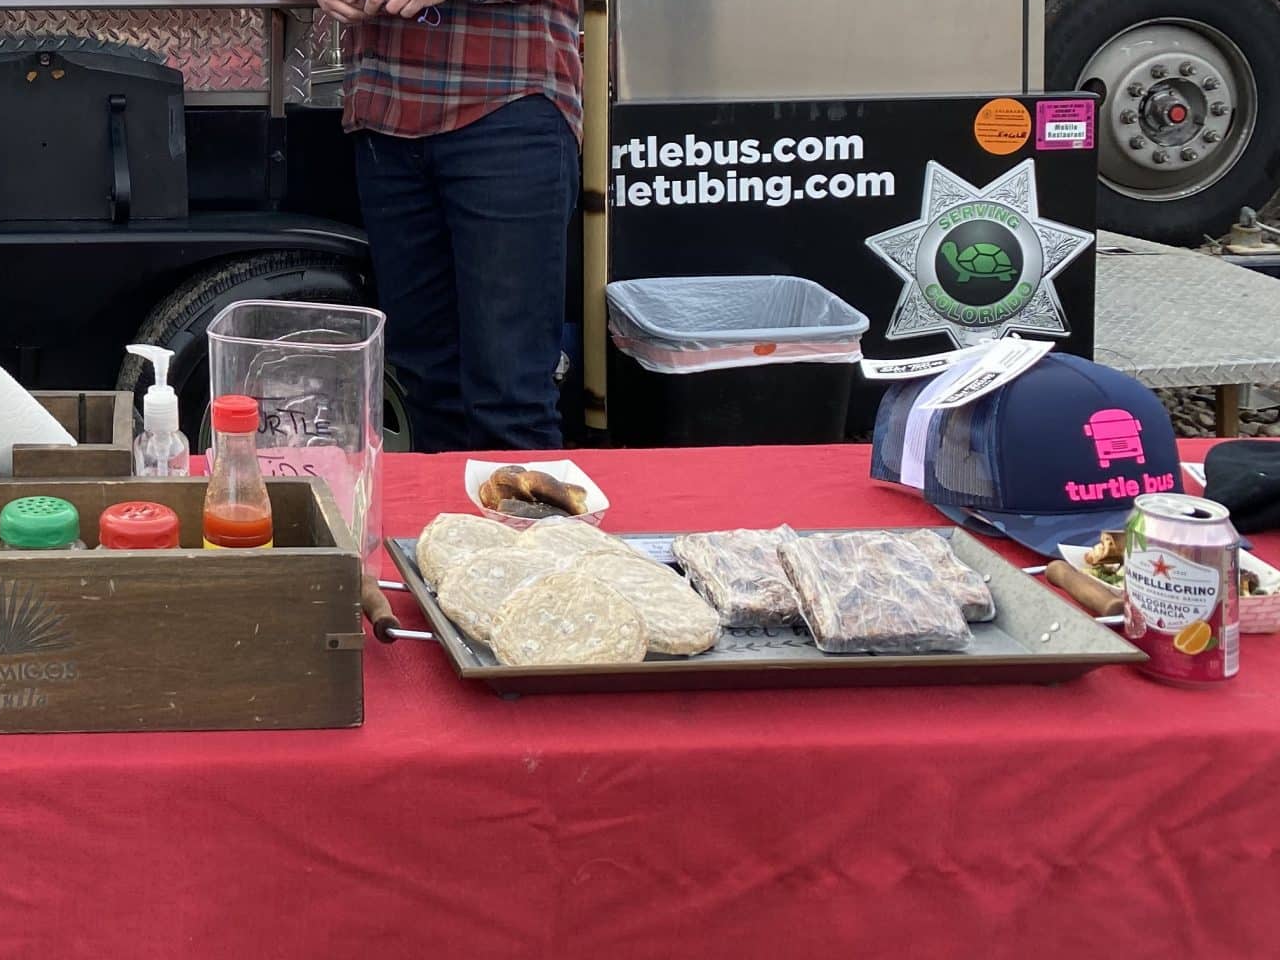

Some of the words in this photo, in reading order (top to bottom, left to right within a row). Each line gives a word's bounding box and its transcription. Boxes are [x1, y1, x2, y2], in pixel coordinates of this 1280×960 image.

[609, 170, 895, 207] letubing.com
[939, 204, 1020, 230] SERVING
[925, 282, 1032, 324] COLORADO
[1065, 476, 1139, 501] turtle
[1143, 473, 1174, 493] bus
[1127, 568, 1215, 596] ANPELLEGRINO
[1132, 591, 1190, 614] MELOGRANO
[1141, 603, 1185, 619] ARANCIA
